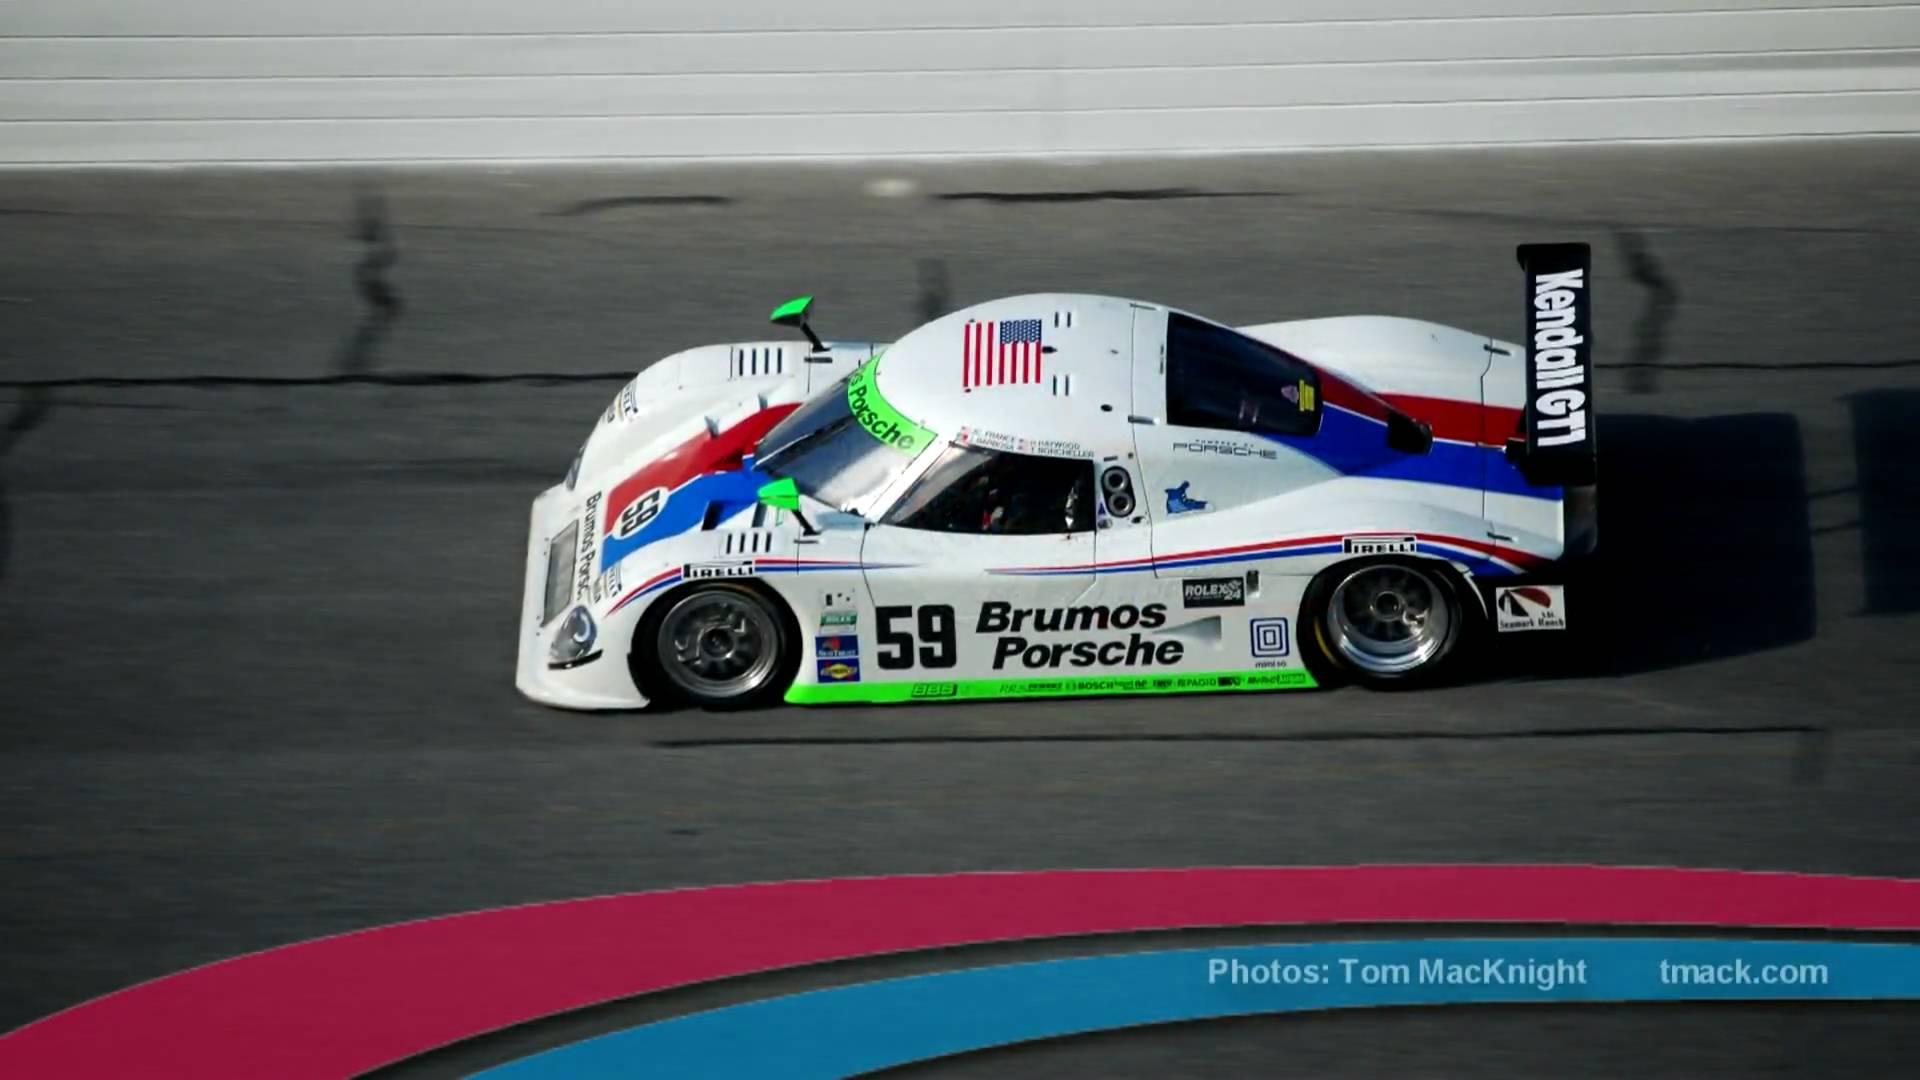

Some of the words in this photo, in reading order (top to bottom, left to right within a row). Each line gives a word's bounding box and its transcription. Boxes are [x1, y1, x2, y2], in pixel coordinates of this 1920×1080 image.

[1534, 268, 1584, 389] Kendall
[849, 385, 915, 449] Porsche
[1173, 442, 1278, 460] PORSCHE
[581, 490, 602, 553] Brumos
[620, 488, 661, 537] 59
[1344, 536, 1415, 553] PIRELLI
[683, 560, 753, 578] PIRELLI
[1184, 583, 1228, 597] ROLEX
[1224, 589, 1243, 600] 24
[975, 601, 1168, 633] Brumos
[875, 604, 957, 670] 59
[992, 633, 1185, 670] Porsche
